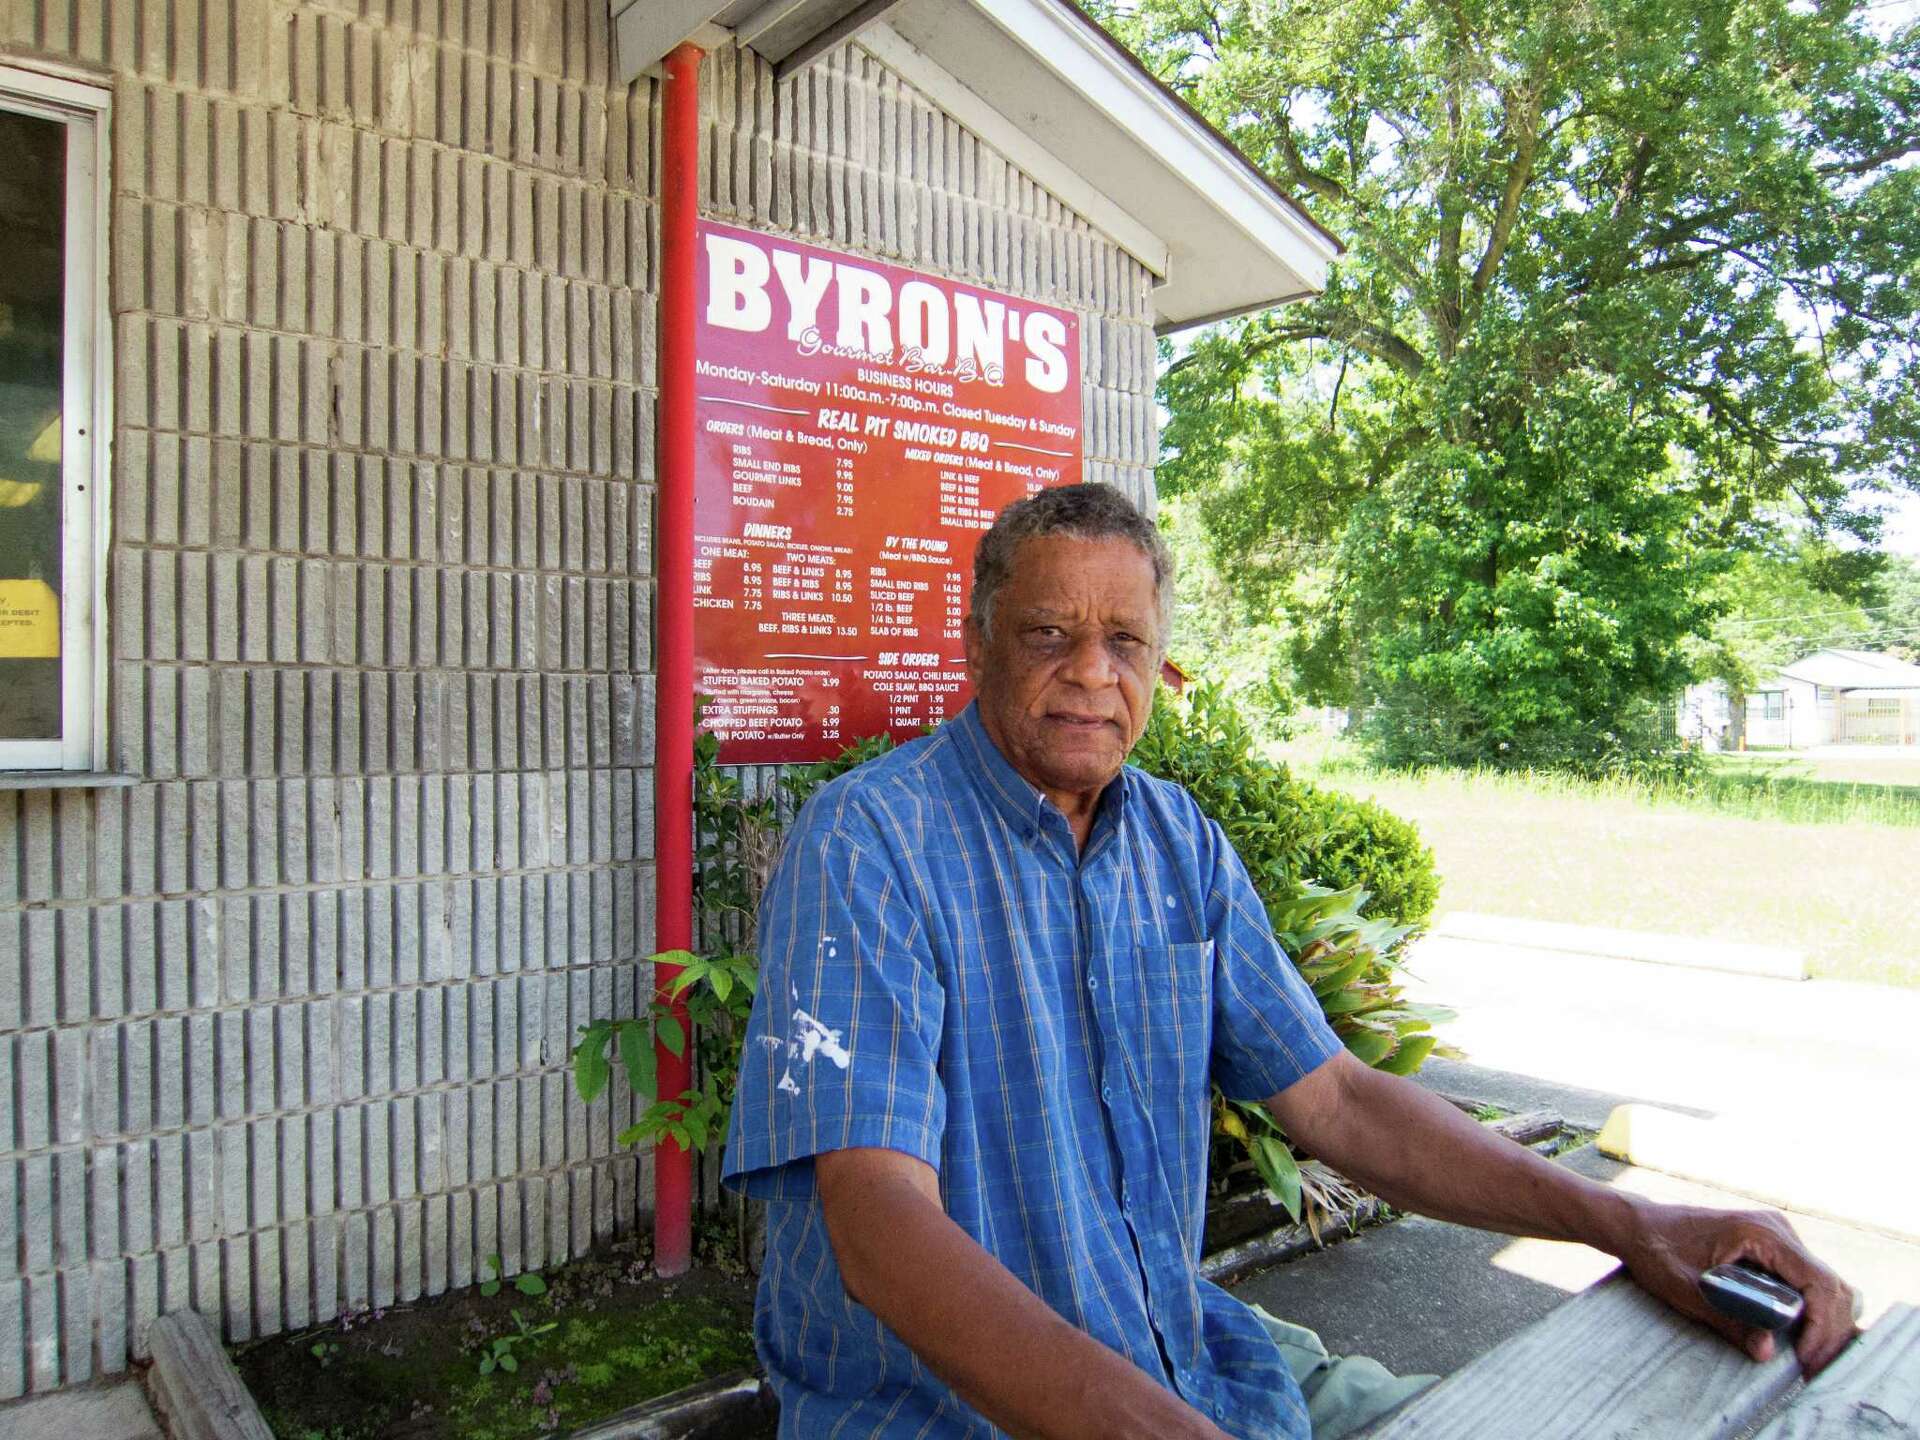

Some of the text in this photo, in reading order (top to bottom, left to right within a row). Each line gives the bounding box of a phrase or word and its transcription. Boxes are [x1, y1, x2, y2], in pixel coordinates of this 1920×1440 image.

[705, 233, 1068, 393] BYRON'S
[797, 325, 894, 366] Gourmet
[858, 368, 953, 397] BUSINESS HOURS
[696, 360, 1076, 439] Monday-Saturday 11:00a.m.-7:00p.m. Closed Tuesday & Sunday
[817, 408, 989, 452] REAL PIT SMOKED BBQ
[706, 420, 868, 454] ORDERS (Meat & Bread, Only)
[733, 444, 854, 468] RIBS 7.95
[733, 458, 854, 481] SMALL END RIBS 9.95
[904, 448, 1060, 482] MIXED ORDERS (Meat & Bread, Only)
[733, 471, 854, 492] GOURMET LINKS 9.00
[940, 470, 980, 484] LINK & BEEF
[733, 482, 854, 505] BEEF 7.95
[940, 482, 979, 495] BEEF & RIBS
[733, 495, 854, 517] BOUDAIN 2.75
[940, 494, 979, 506] LINK & RIBS
[940, 505, 956, 514] LINK
[973, 508, 978, 517] &
[940, 516, 963, 527] SMALL
[964, 519, 979, 528] END
[743, 523, 792, 540] DINNERS
[885, 535, 948, 552] BY THE POUND
[701, 546, 750, 559] ONE MEAT:
[786, 552, 836, 565] TWO MEATS:
[879, 551, 901, 561] (Meat
[772, 564, 791, 574] BEEF
[793, 565, 800, 575] &
[802, 566, 824, 577] LINKS
[870, 566, 887, 576] RIBS
[693, 572, 712, 582] RIBS
[772, 577, 792, 588] BEEF
[793, 578, 800, 588] &
[802, 578, 820, 589] RIBS
[692, 585, 762, 598] LINK 7.75
[870, 578, 961, 593] SMALL END RIBS 14.50
[772, 590, 791, 600] RIBS
[792, 591, 799, 601] &
[801, 591, 824, 602] LINKS
[870, 590, 896, 601] SLICED
[898, 592, 914, 602] BEEF
[693, 597, 762, 611] CHICKEN 7.75
[871, 602, 884, 612] 1/2
[885, 602, 894, 612] lb.
[896, 604, 913, 613] BEEF
[782, 611, 836, 623] THREE MEATS:
[871, 614, 884, 624] 1/4
[885, 614, 894, 624] lb.
[896, 615, 913, 625] BEEF
[758, 623, 780, 633] BEEF,
[782, 624, 800, 634] RIBS
[801, 624, 807, 634] &
[809, 624, 832, 635] LINKS
[870, 627, 961, 639] SLAB OF RIBS 16.95
[878, 652, 940, 667] SIDE ORDERS
[703, 676, 840, 687] STUFFED BAKED POTATO 3.99
[863, 670, 967, 681] POTATO SALAD, CHILI BEANS,
[873, 682, 960, 692] COLE SLAW, BBQ SAUCE
[889, 694, 944, 704] 1/2 PINT 1.95
[702, 705, 731, 715] EXTRA
[733, 705, 778, 715] STUFFINGS
[895, 706, 912, 714] PINT
[928, 706, 944, 715] 3.25
[702, 717, 746, 728] CHOPPED
[749, 718, 768, 727] BEEF
[770, 718, 803, 727] POTATO
[895, 717, 920, 727] QUART
[731, 730, 765, 740] POTATO
[791, 733, 805, 741] Only
[822, 730, 840, 739] 3.25
